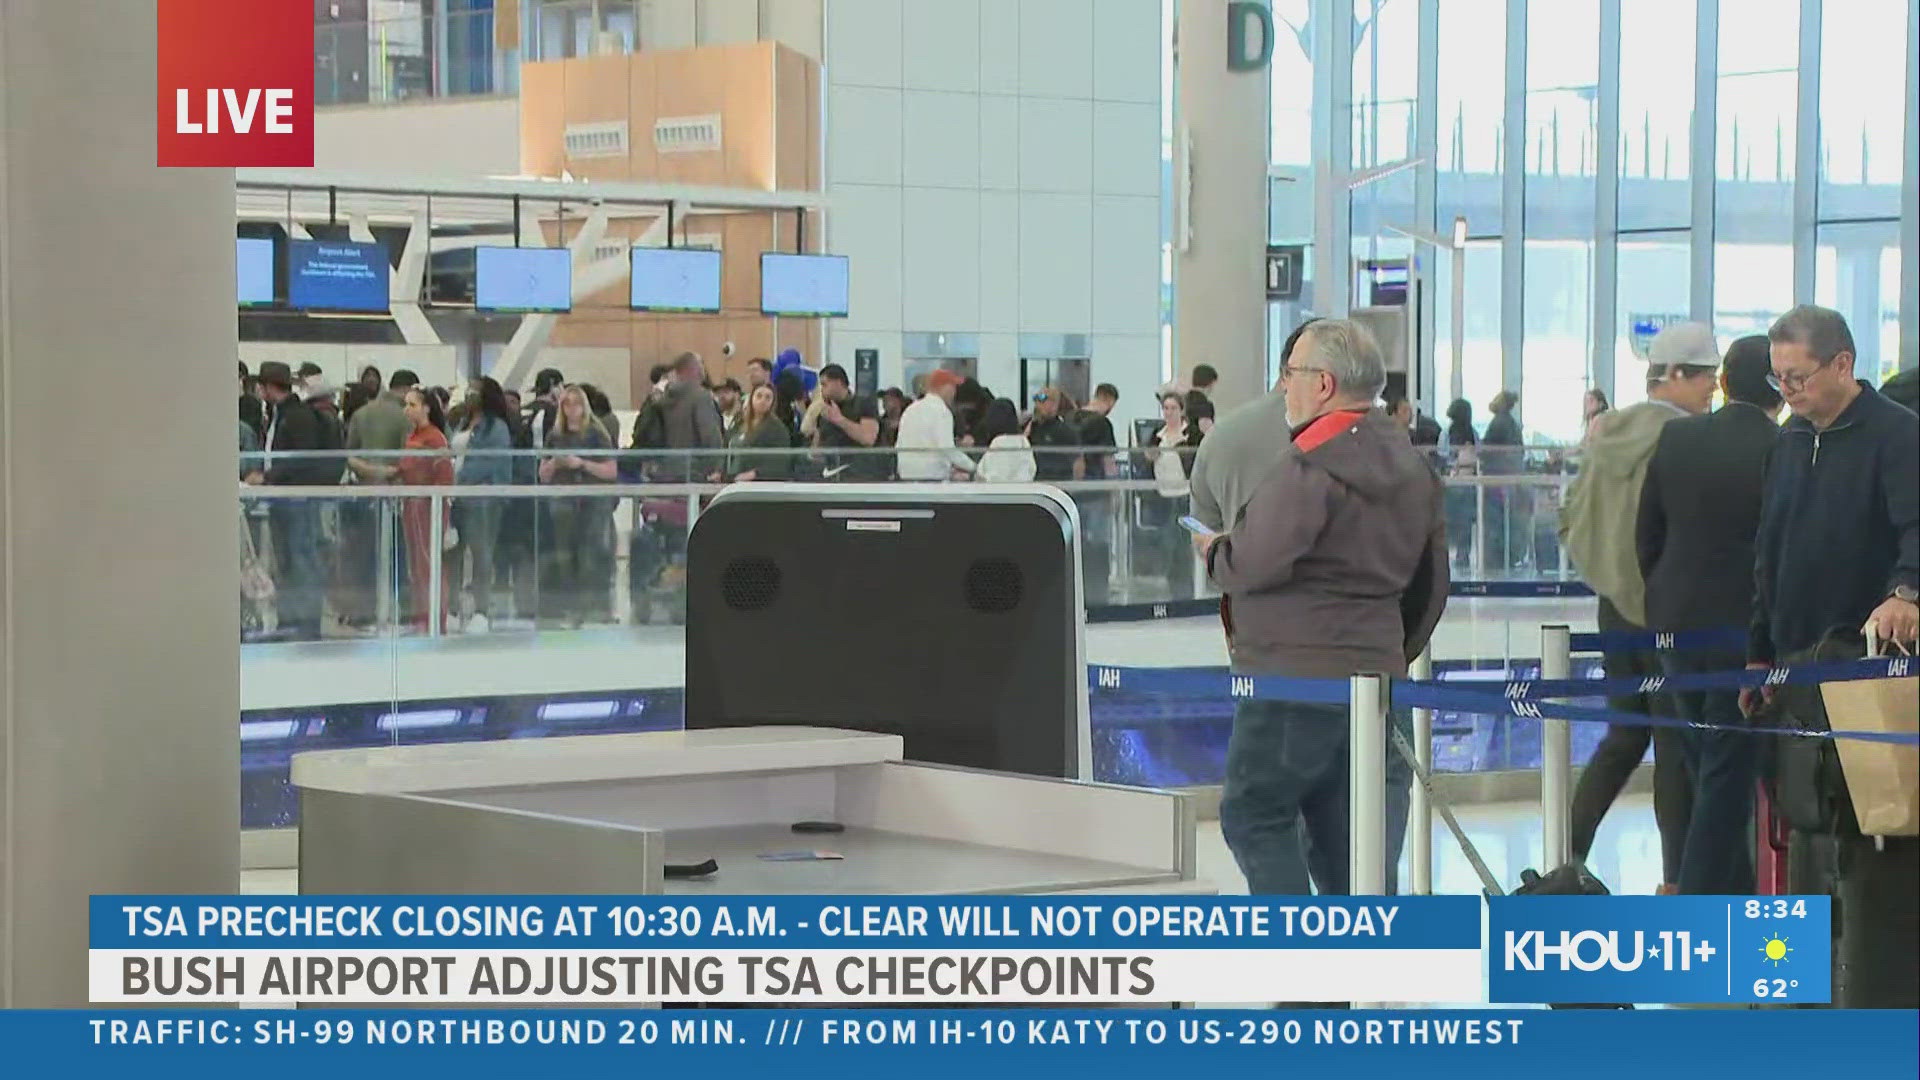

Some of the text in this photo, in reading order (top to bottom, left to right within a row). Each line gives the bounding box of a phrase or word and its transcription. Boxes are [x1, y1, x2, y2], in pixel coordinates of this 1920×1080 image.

[1227, 1, 1274, 72] D
[1655, 632, 1674, 649] IAH
[1765, 667, 1790, 685] IAH
[1887, 658, 1909, 676] IAH
[1099, 667, 1120, 688] IAH
[1231, 676, 1254, 697] IAH
[1638, 676, 1665, 693] IAH
[1504, 682, 1530, 699] IAH
[1511, 700, 1542, 718] IAH
